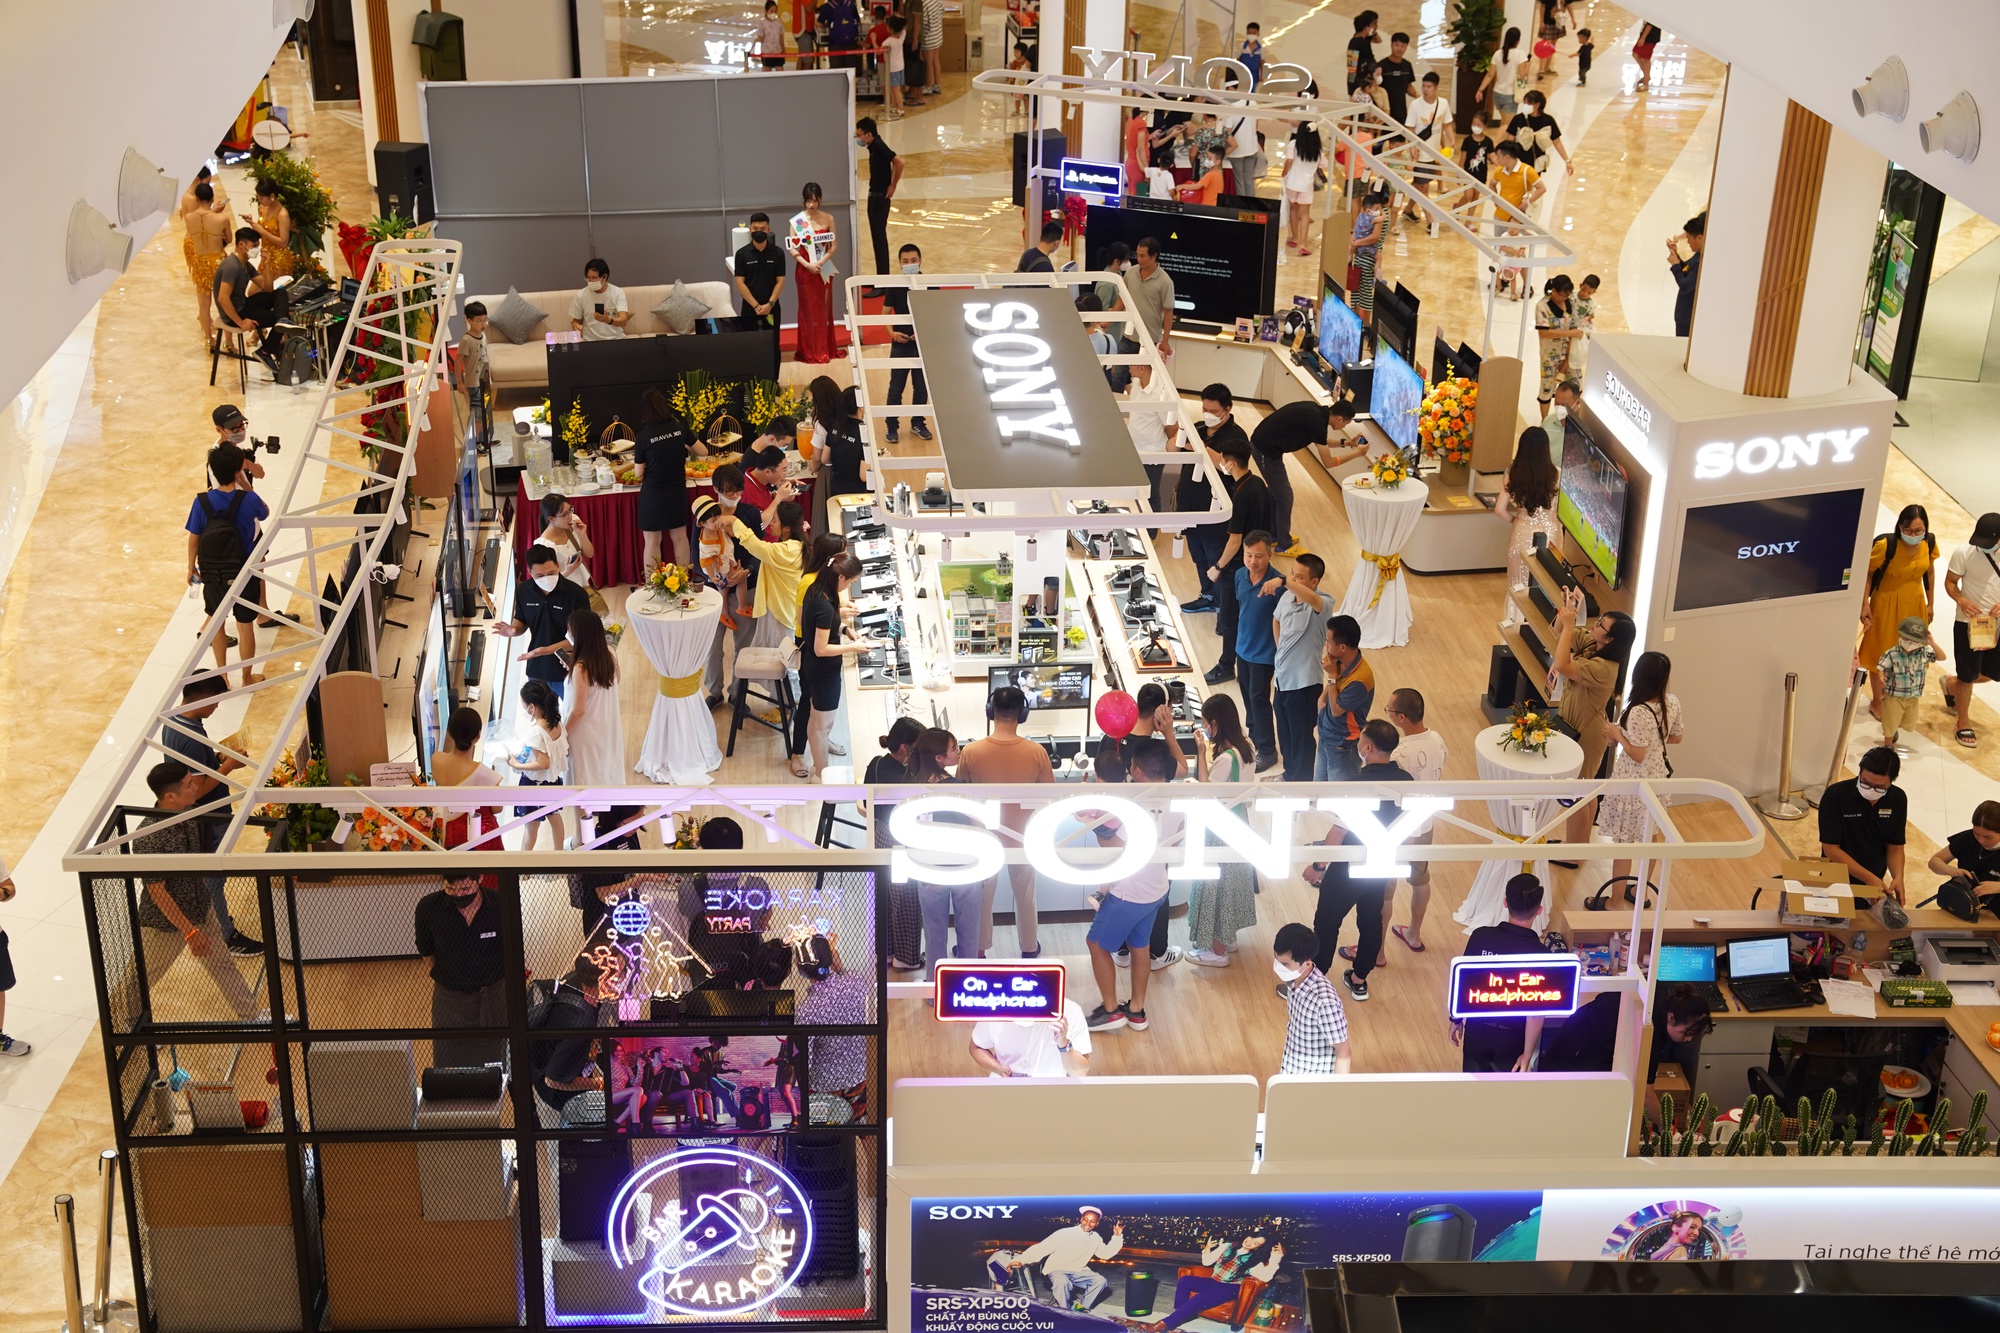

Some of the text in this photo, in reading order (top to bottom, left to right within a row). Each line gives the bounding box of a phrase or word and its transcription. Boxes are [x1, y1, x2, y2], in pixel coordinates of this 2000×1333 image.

[813, 234, 834, 242] SAMNEC
[963, 302, 1081, 450] SONY
[1605, 371, 1651, 432] SOUNDBAR
[650, 432, 673, 444] BRAVIA
[1694, 427, 1869, 479] SONY
[1737, 541, 1800, 559] SONY
[889, 794, 1454, 885] SONY
[963, 976, 988, 991] On
[1011, 976, 1039, 991] Ear
[1488, 972, 1503, 987] In
[1518, 972, 1545, 986] Ear
[953, 992, 1048, 1011] Headphones
[1468, 987, 1562, 1006] Headphones
[929, 1205, 1019, 1220] SONY
[641, 1204, 688, 1243] BAR
[1332, 1254, 1392, 1263] SRS-XP500
[1803, 1244, 1833, 1259] Tai
[1839, 1244, 1892, 1260] nghe
[1899, 1244, 1932, 1260] thế
[665, 1228, 796, 1305] KARAOKE
[926, 1296, 1031, 1311] SRS-XP500
[926, 1308, 1031, 1322] CHẤT ÂM BÙNG NỔ,
[926, 1321, 1054, 1332] KHUẤY ĐỘNG CUỘC VUI
